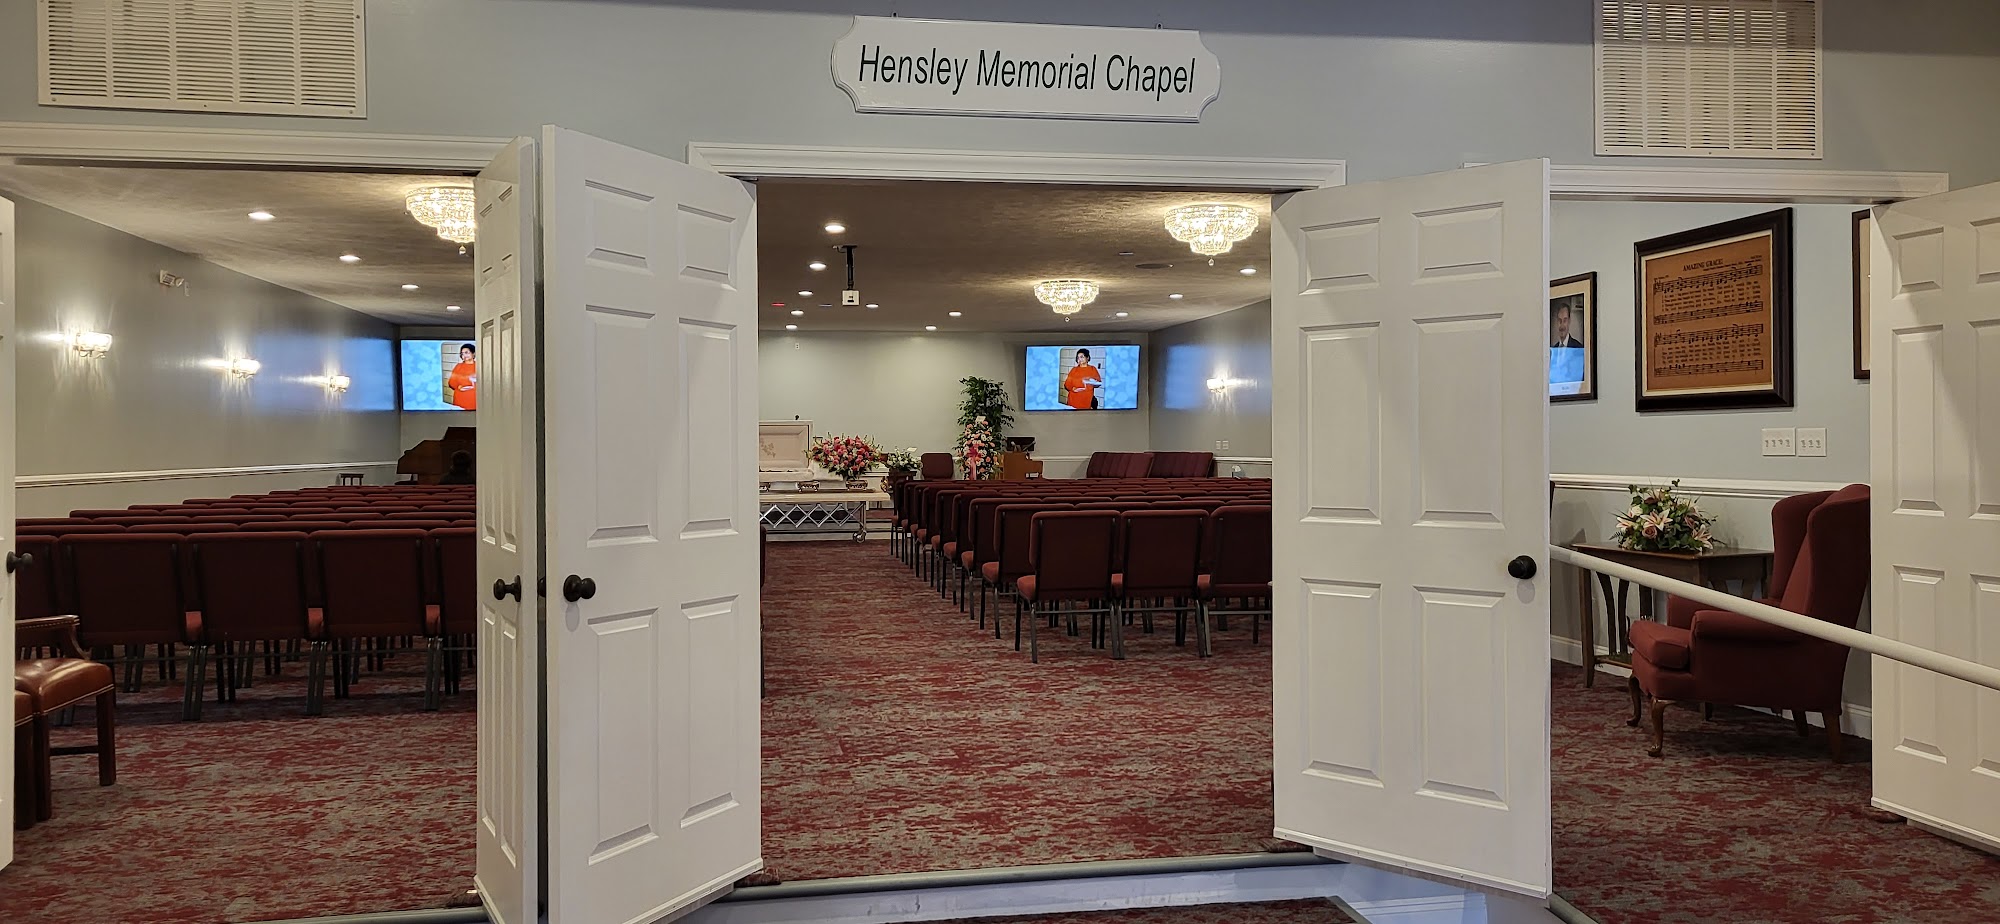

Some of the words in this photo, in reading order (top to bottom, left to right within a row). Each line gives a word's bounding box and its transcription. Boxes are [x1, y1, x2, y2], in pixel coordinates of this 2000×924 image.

[858, 45, 969, 95] Hensley
[976, 50, 1097, 90] Memorial
[1106, 55, 1196, 102] Chapel
